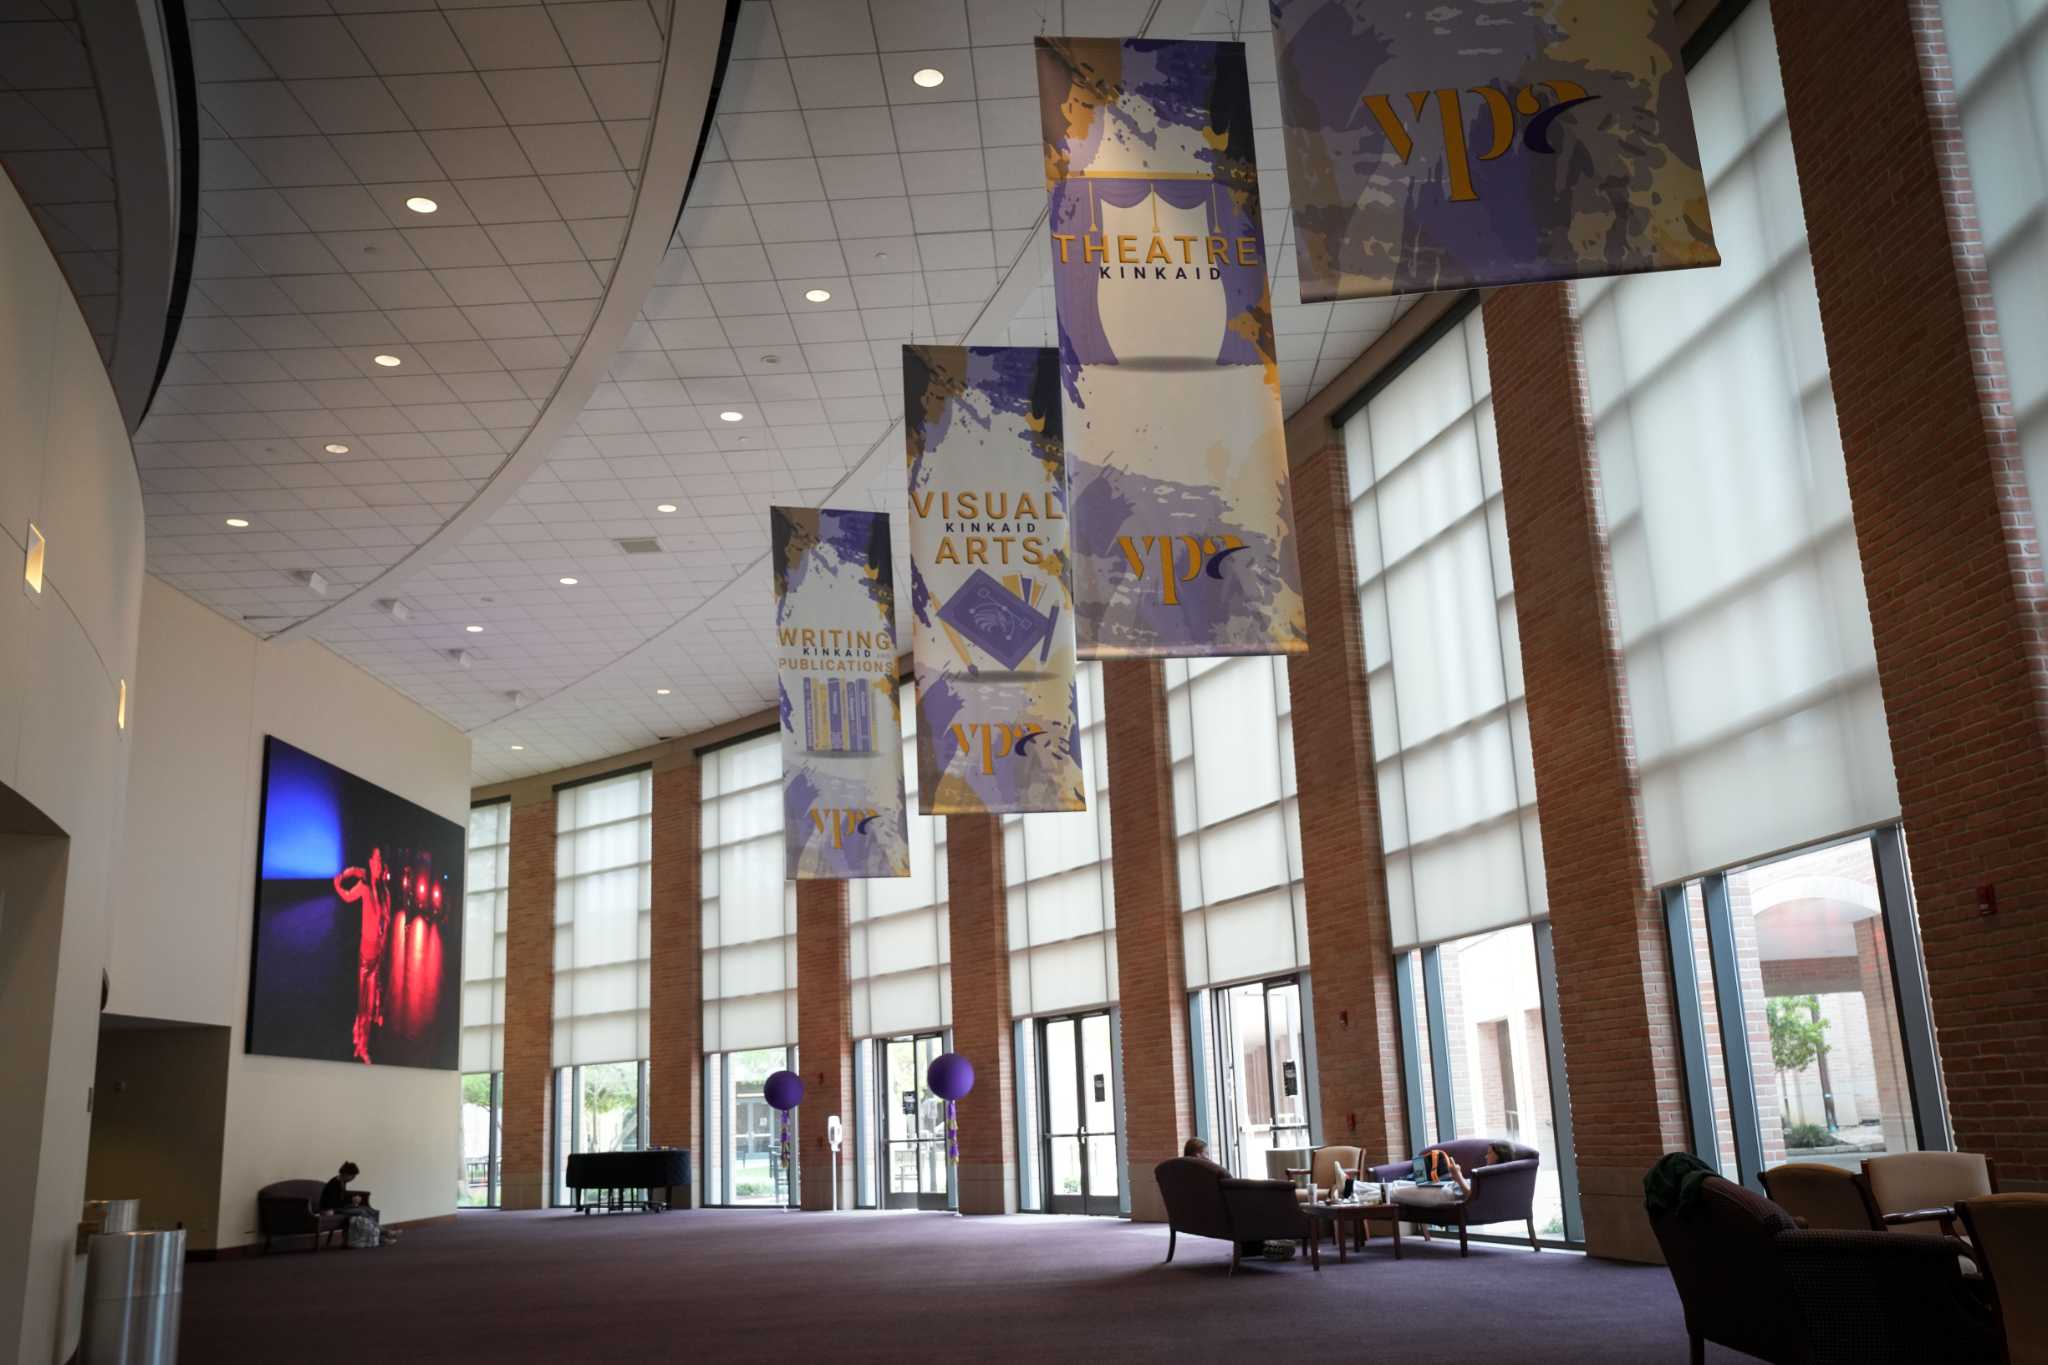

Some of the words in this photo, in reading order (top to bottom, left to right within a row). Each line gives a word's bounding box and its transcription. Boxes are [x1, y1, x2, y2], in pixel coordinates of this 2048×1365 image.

[1053, 234, 1259, 266] THEATRE
[1100, 266, 1221, 280] KINKAID
[911, 490, 1065, 520] VISUAL
[946, 522, 1036, 533] KINKAID
[935, 536, 1043, 565] ARTS
[779, 628, 890, 650] WRITING
[803, 647, 871, 658] KINKAID
[778, 658, 894, 673] PUBLICATIONS
